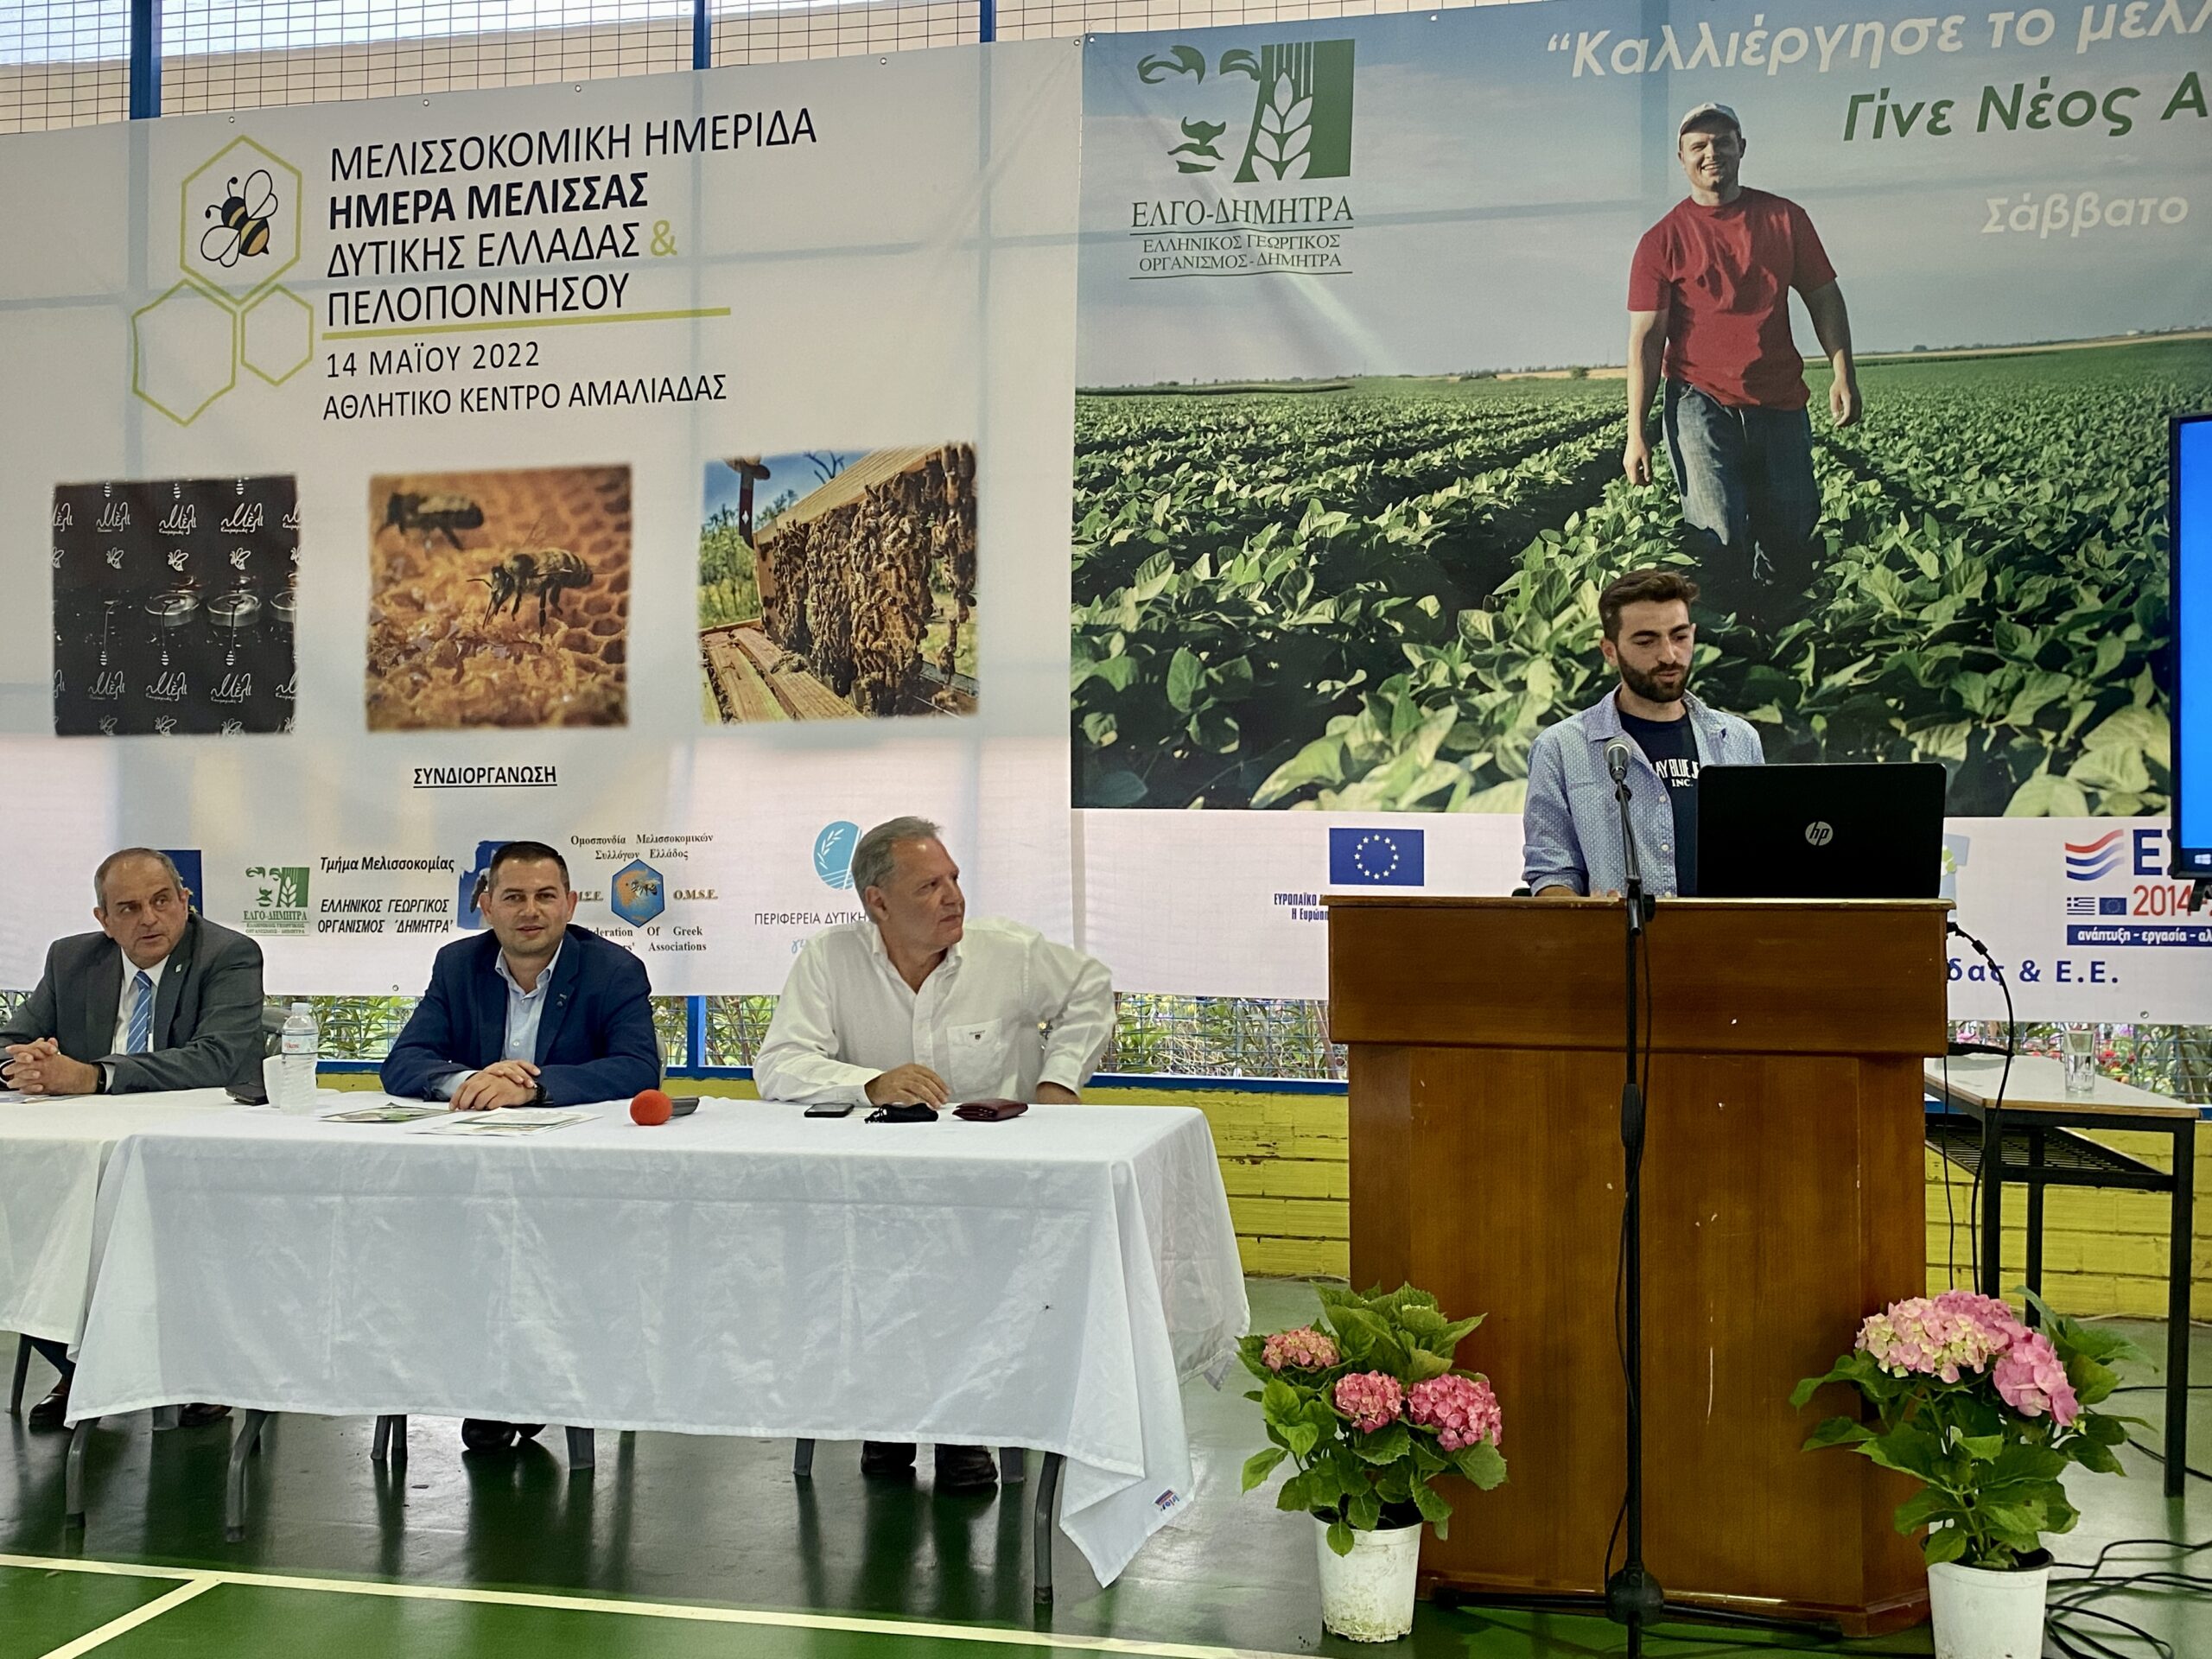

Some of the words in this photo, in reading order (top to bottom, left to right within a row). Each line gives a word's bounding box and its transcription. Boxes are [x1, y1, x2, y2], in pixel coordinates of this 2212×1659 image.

[1988, 6, 2055, 49] το
[1842, 87, 1954, 143] Γίνε
[1977, 76, 2140, 137] Νέος
[2160, 71, 2209, 121] Α
[331, 124, 631, 182] ΜΕΛΙΣΣΟΚΟΜΙΚΗ
[645, 108, 817, 156] ΗΜΕΡΙΔΑ
[329, 188, 456, 231] ΗΜΕΡΑ
[467, 172, 649, 220] ΜΕΛΙΣΣΑΣ
[1130, 195, 1355, 228] ΕΛΓΟ-ΔΗΜΗΤΡΑ
[1981, 190, 2190, 239] Σάββατο
[327, 234, 466, 278] ΔΥΤΙΚΗΣ
[478, 222, 640, 268] ΕΛΛΑΔΑΣ
[650, 219, 678, 257] &
[1142, 235, 1243, 253] ΕΛΛΗΝΙΚΟΣ
[1246, 234, 1341, 251] ΓΕΩΡΓΙΚΟΣ
[328, 272, 630, 327] ΠΕΛΟΠΟΝΝΗΣΟΥ
[327, 353, 357, 378] 14
[370, 342, 461, 376] ΜΑΪΟΥ
[473, 341, 540, 370] 2022
[322, 389, 452, 421] ΑΘΛΗΤΙΚΟ
[461, 384, 561, 413] ΚΕΝΤΡΟ
[569, 374, 727, 408] ΑΜΑΛΙΑΔΑΣ
[413, 766, 557, 785] ΣΥΝΔΙΟΡΓΑΝΩΣΗ
[1650, 760, 1668, 779] AY
[1669, 759, 1691, 779] BLUE
[570, 835, 626, 848] Ομοσπονδία
[636, 833, 714, 845] Μελισσοκομικών
[1807, 822, 1831, 846] hp
[321, 856, 359, 874] Τμήμα
[361, 855, 454, 874] Μελισσοκομίας
[594, 850, 640, 862] Συλλόγων
[650, 849, 689, 861] Ελλάδος
[243, 911, 308, 921] ΕΛΓΟ-ΔΗΜΗΤΡΑ
[321, 899, 383, 913] ΕΛΛΗΝΙΚΟΣ
[388, 899, 449, 913] ΓΕΩΡΓΙΚΟΣ
[317, 919, 385, 933] ΟΡΓΑΝΙΣΜΟΣ
[754, 912, 821, 925] ΠΕΡΙΦΕΡΕΙΑ
[824, 912, 868, 925] ΔΥΤΙΚΗ
[647, 926, 660, 937] Of
[673, 925, 703, 937] Greek
[2077, 926, 2131, 944] ανάπτυξη
[2142, 927, 2187, 945] εργασία
[2198, 928, 2212, 943] αλ
[648, 941, 707, 951] Associations
[1948, 957, 2005, 986] δας
[2019, 960, 2041, 982] &
[2056, 960, 2119, 984] Ε.Ε.
